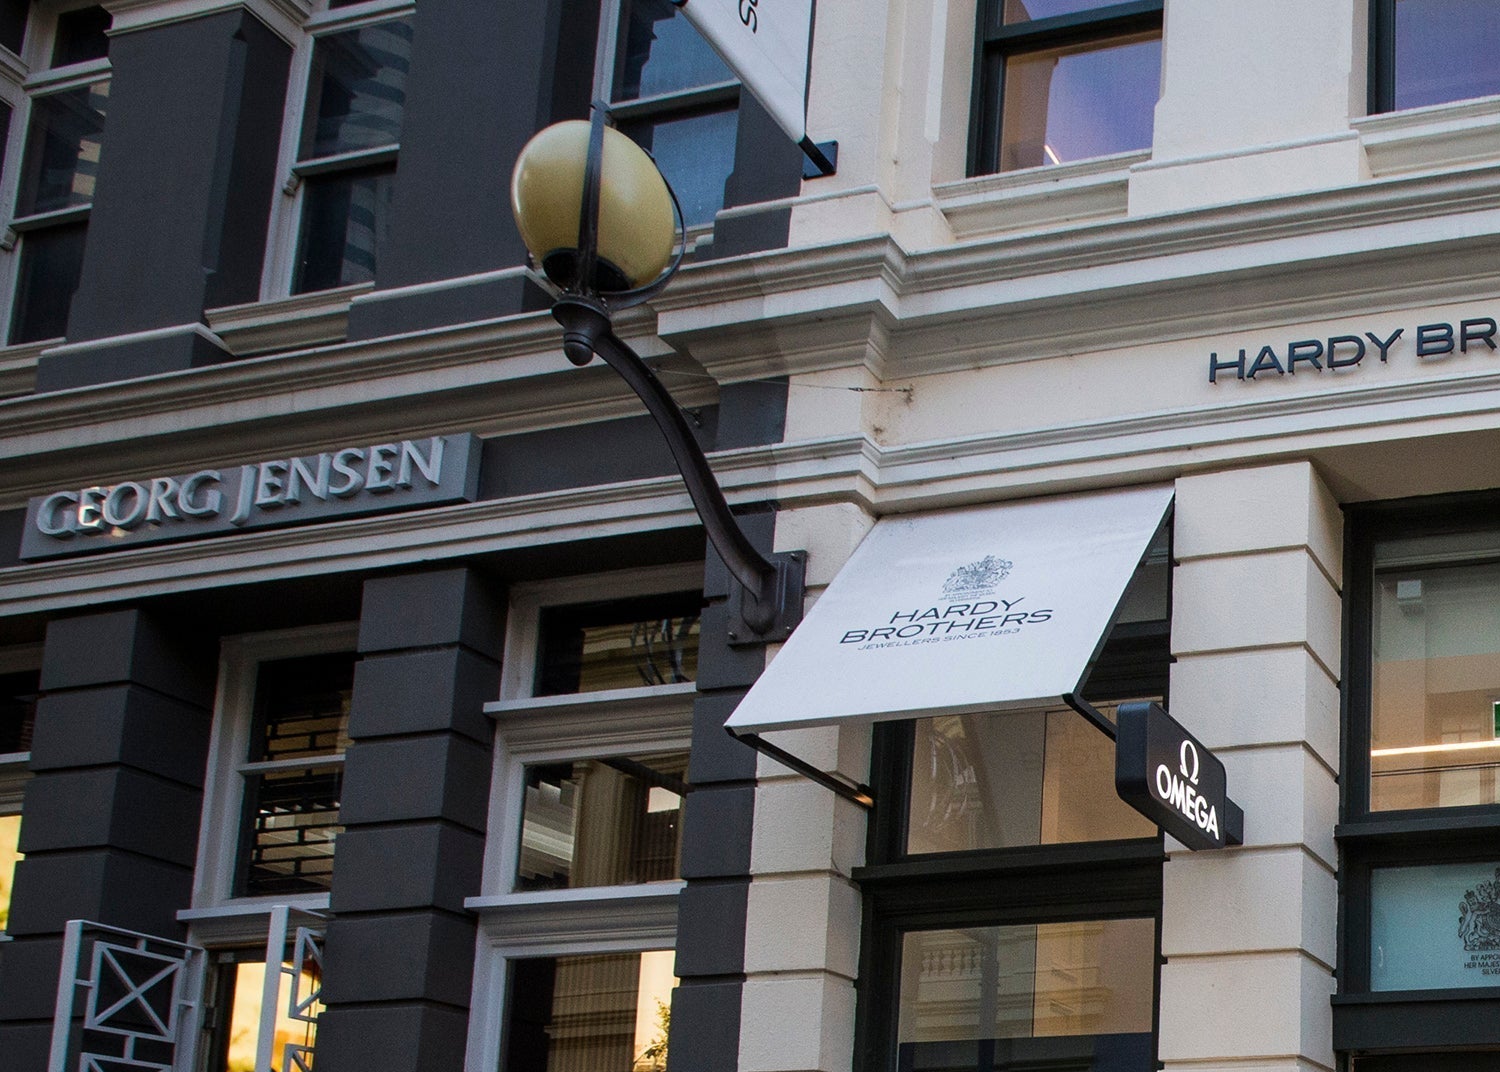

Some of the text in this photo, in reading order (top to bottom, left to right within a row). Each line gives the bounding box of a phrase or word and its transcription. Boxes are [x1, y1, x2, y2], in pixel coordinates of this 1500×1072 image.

[1208, 328, 1405, 383] HARDY
[36, 436, 448, 538] GEORG JENSEN
[840, 609, 1054, 644] BROTHERS
[889, 596, 1025, 624] HARDY
[857, 627, 1021, 651] JEWELLERS SINCE 1853
[1156, 764, 1219, 840] OMEGA
